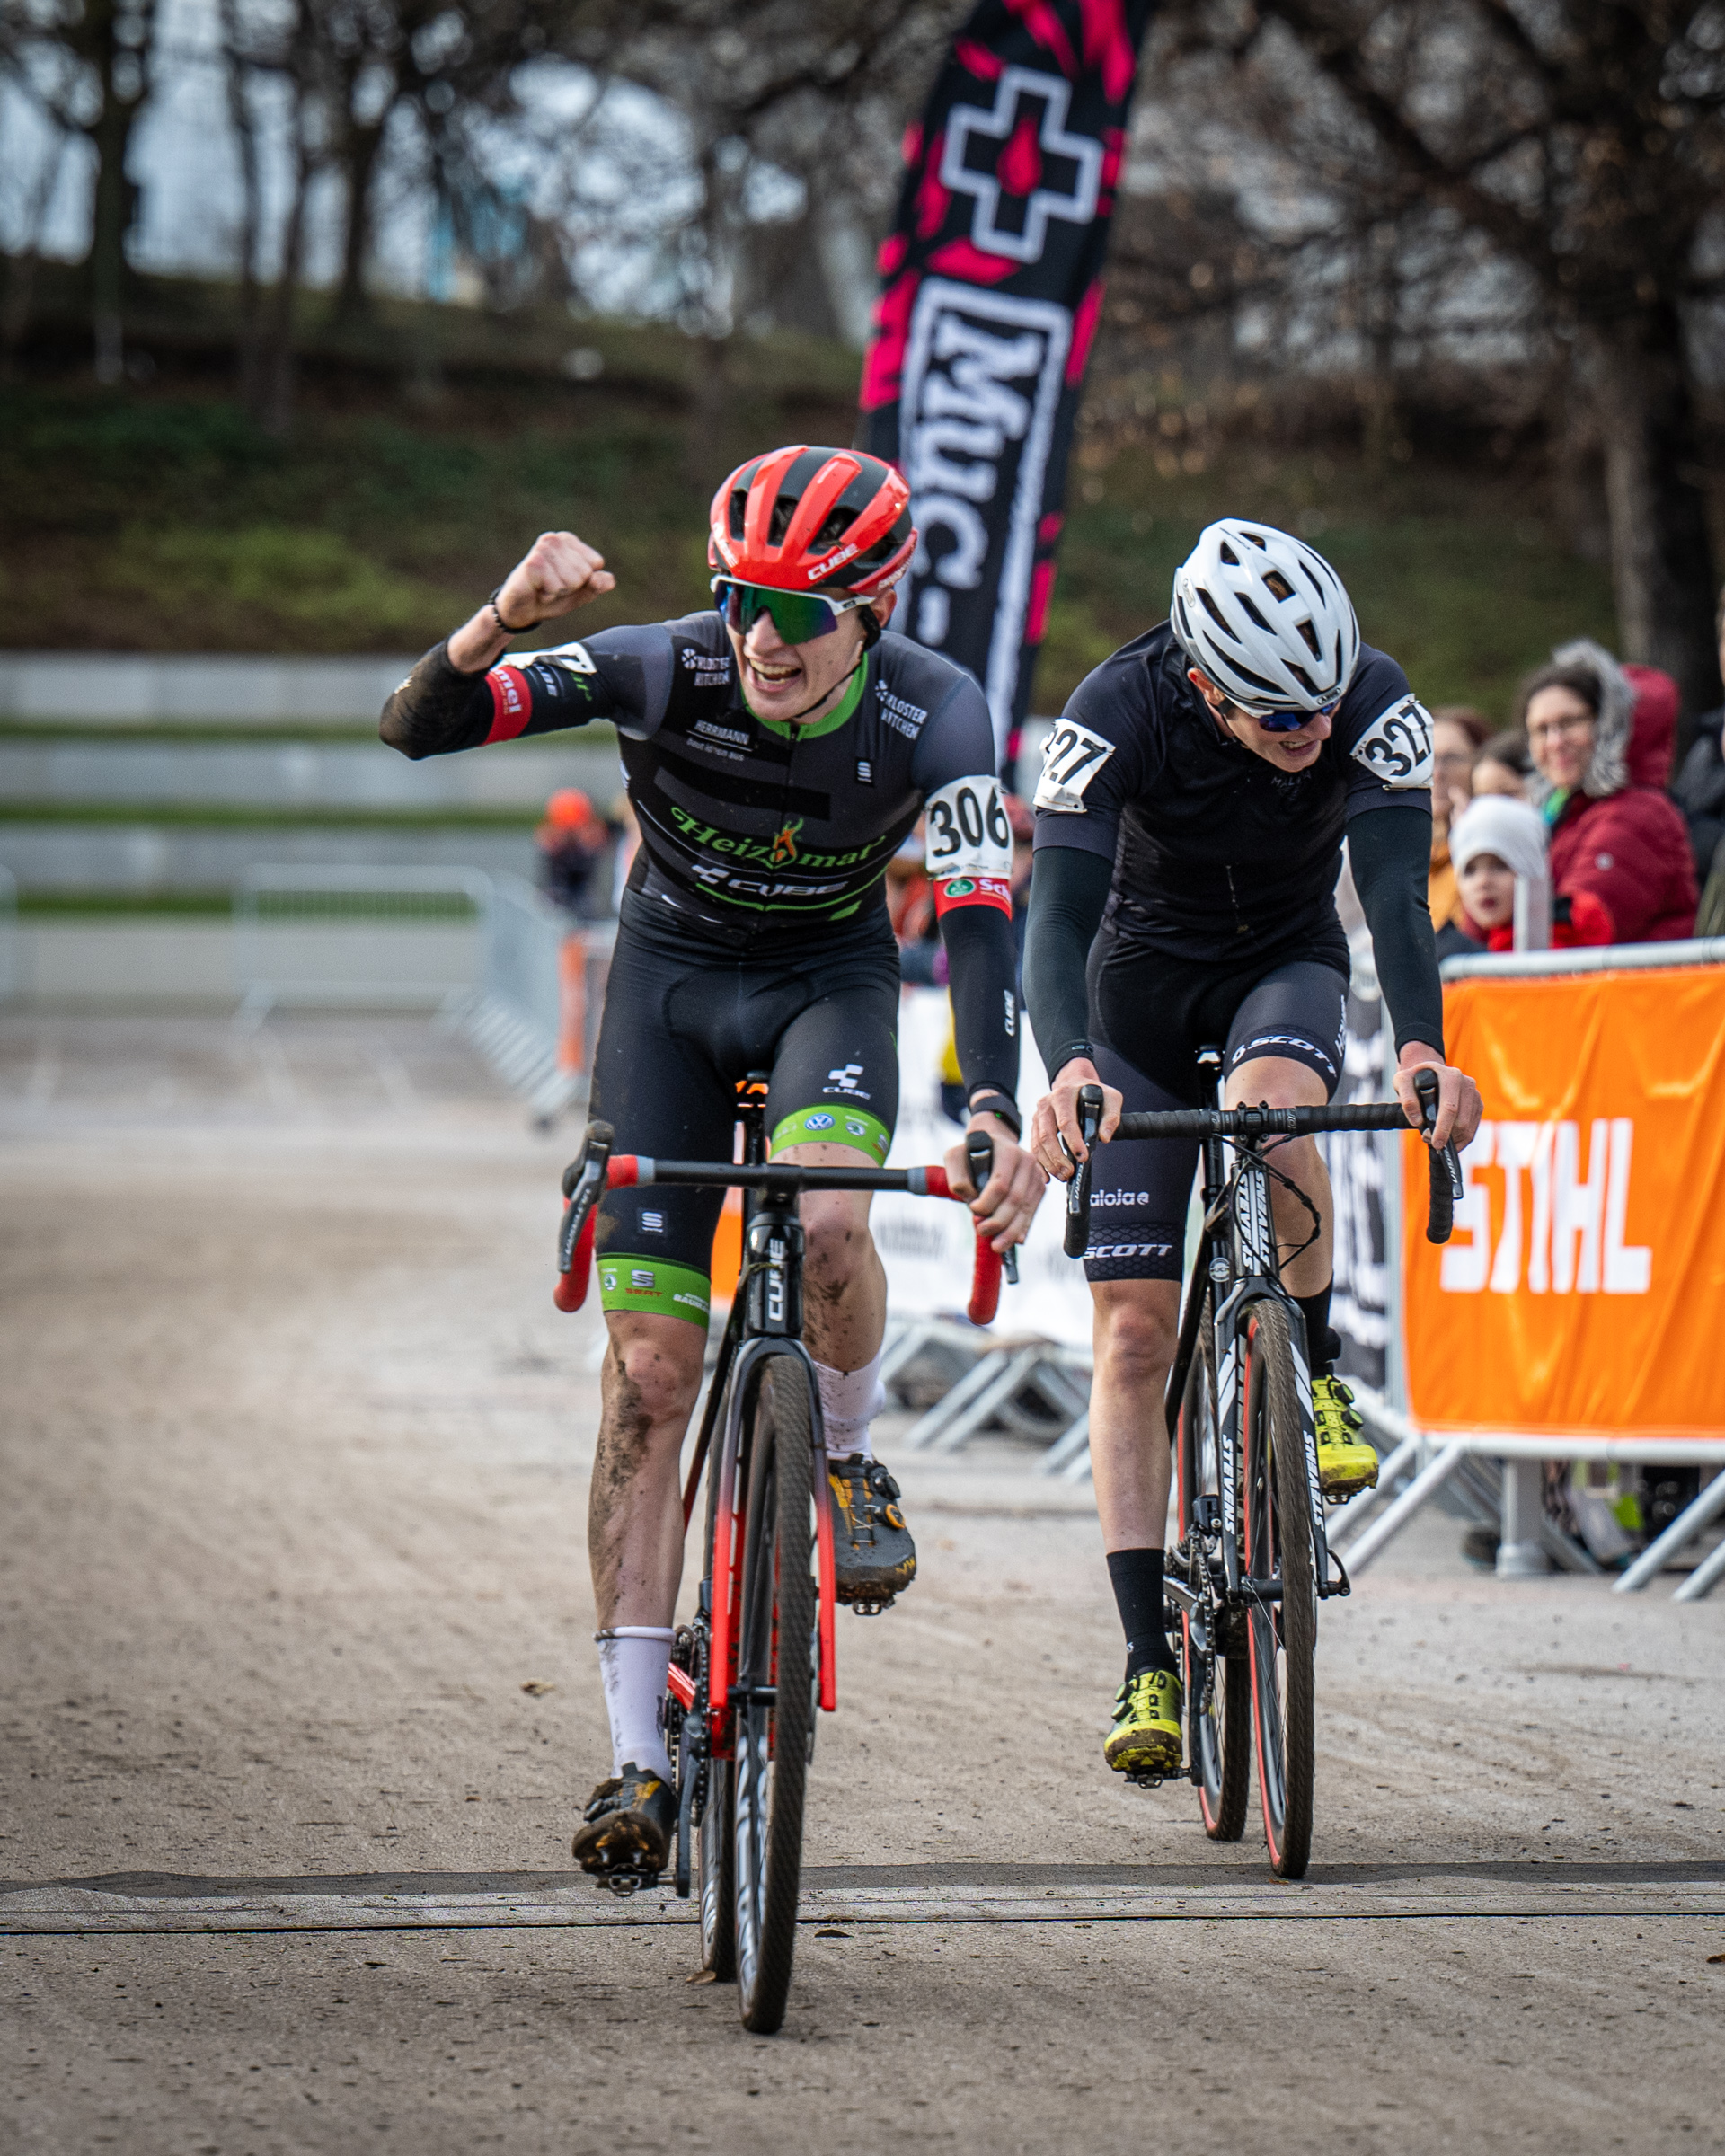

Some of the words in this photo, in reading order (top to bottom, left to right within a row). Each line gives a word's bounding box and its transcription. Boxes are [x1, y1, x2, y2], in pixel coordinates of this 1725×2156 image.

[808, 543, 859, 580] CUBE
[880, 707, 921, 741] KITCHEN
[885, 693, 929, 725] KLOSTER
[694, 719, 750, 746] HERRMANN
[1365, 704, 1432, 777] 327
[930, 786, 1010, 859] 306
[727, 878, 850, 897] CUBE
[1246, 1035, 1338, 1079] SCOTT
[1089, 1188, 1136, 1207] aloja
[1256, 1170, 1271, 1268] STEVENS
[1439, 1118, 1653, 1294] STIHL
[1238, 1173, 1254, 1271] STEVENS
[1082, 1243, 1173, 1259] SCOTT
[1222, 1433, 1235, 1536] STEVENS
[1303, 1429, 1325, 1533] STEVENS
